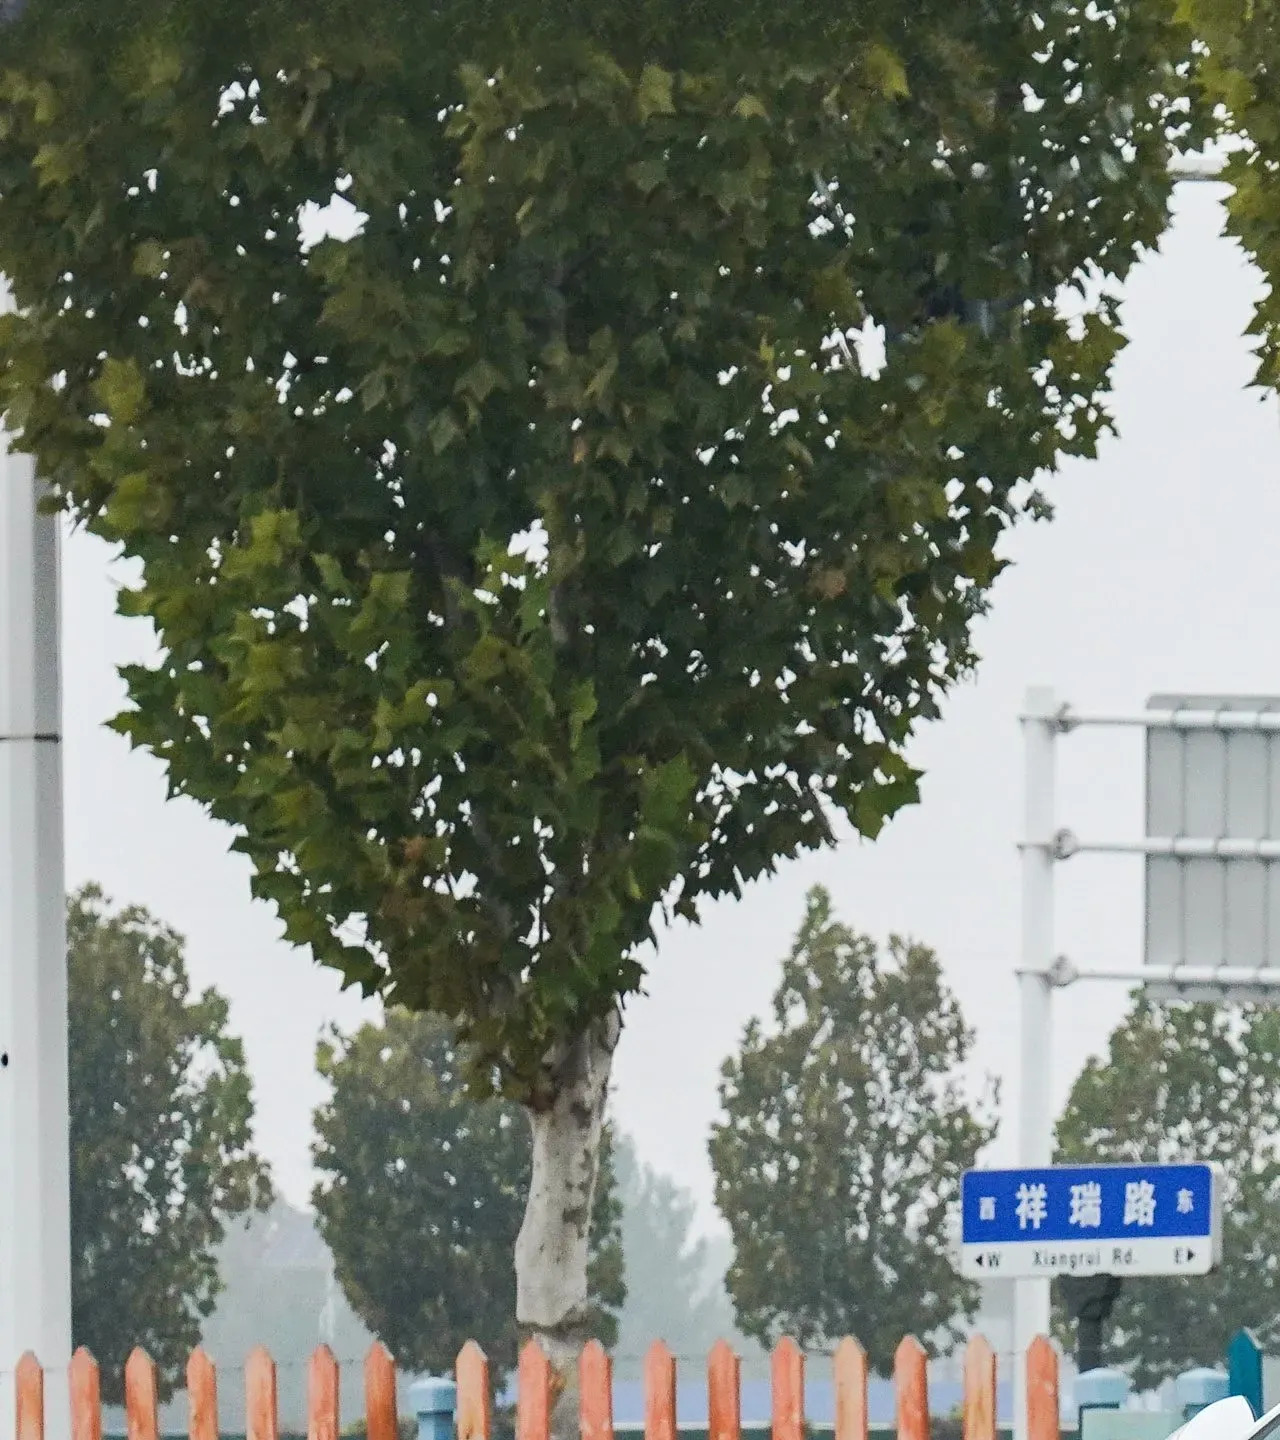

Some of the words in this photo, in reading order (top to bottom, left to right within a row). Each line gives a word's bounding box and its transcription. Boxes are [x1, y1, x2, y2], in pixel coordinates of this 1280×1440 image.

[1015, 1180, 1157, 1230] 祥瑞路
[1032, 1249, 1100, 1269] Xiangrui
